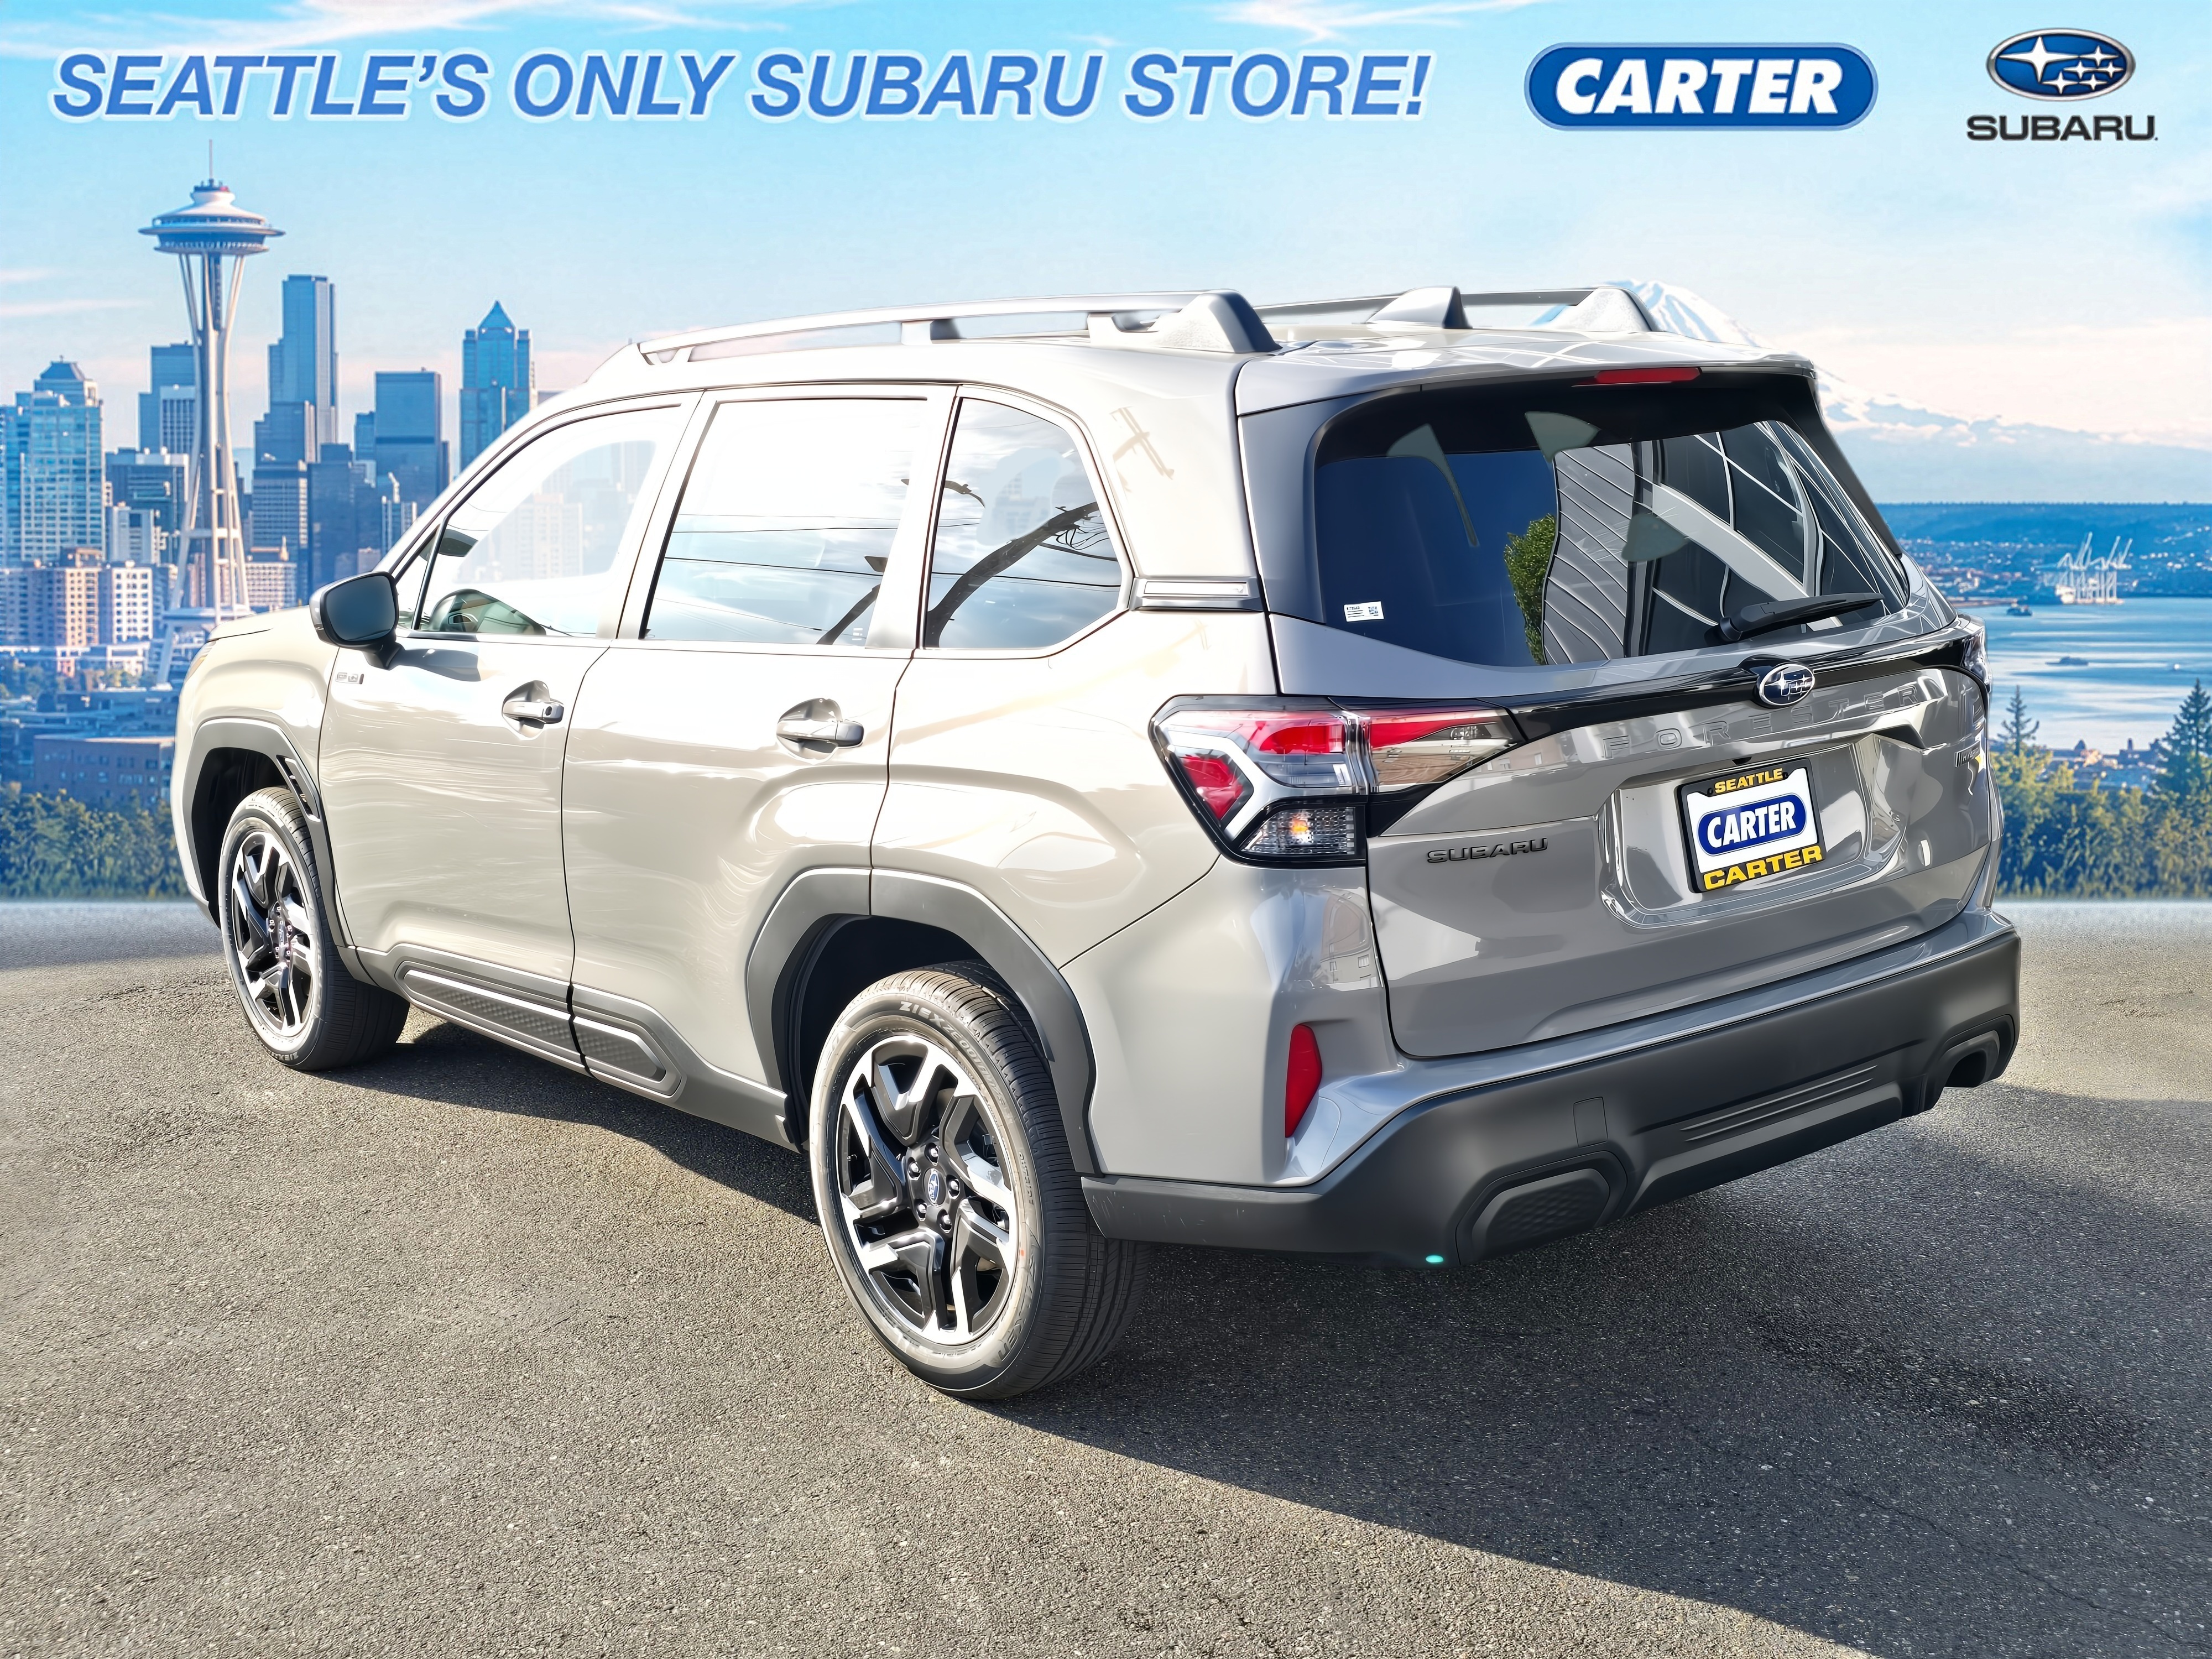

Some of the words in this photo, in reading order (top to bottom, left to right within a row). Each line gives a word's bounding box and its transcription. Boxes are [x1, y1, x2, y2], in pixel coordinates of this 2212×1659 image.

[1603, 685, 1918, 759] FORESTER
[1714, 768, 1783, 794] SEATTLE
[1707, 801, 1797, 848] CARTER
[1427, 837, 1548, 863] SUBARU
[1703, 845, 1823, 890] CARTER
[899, 1000, 945, 1026] ZIEX
